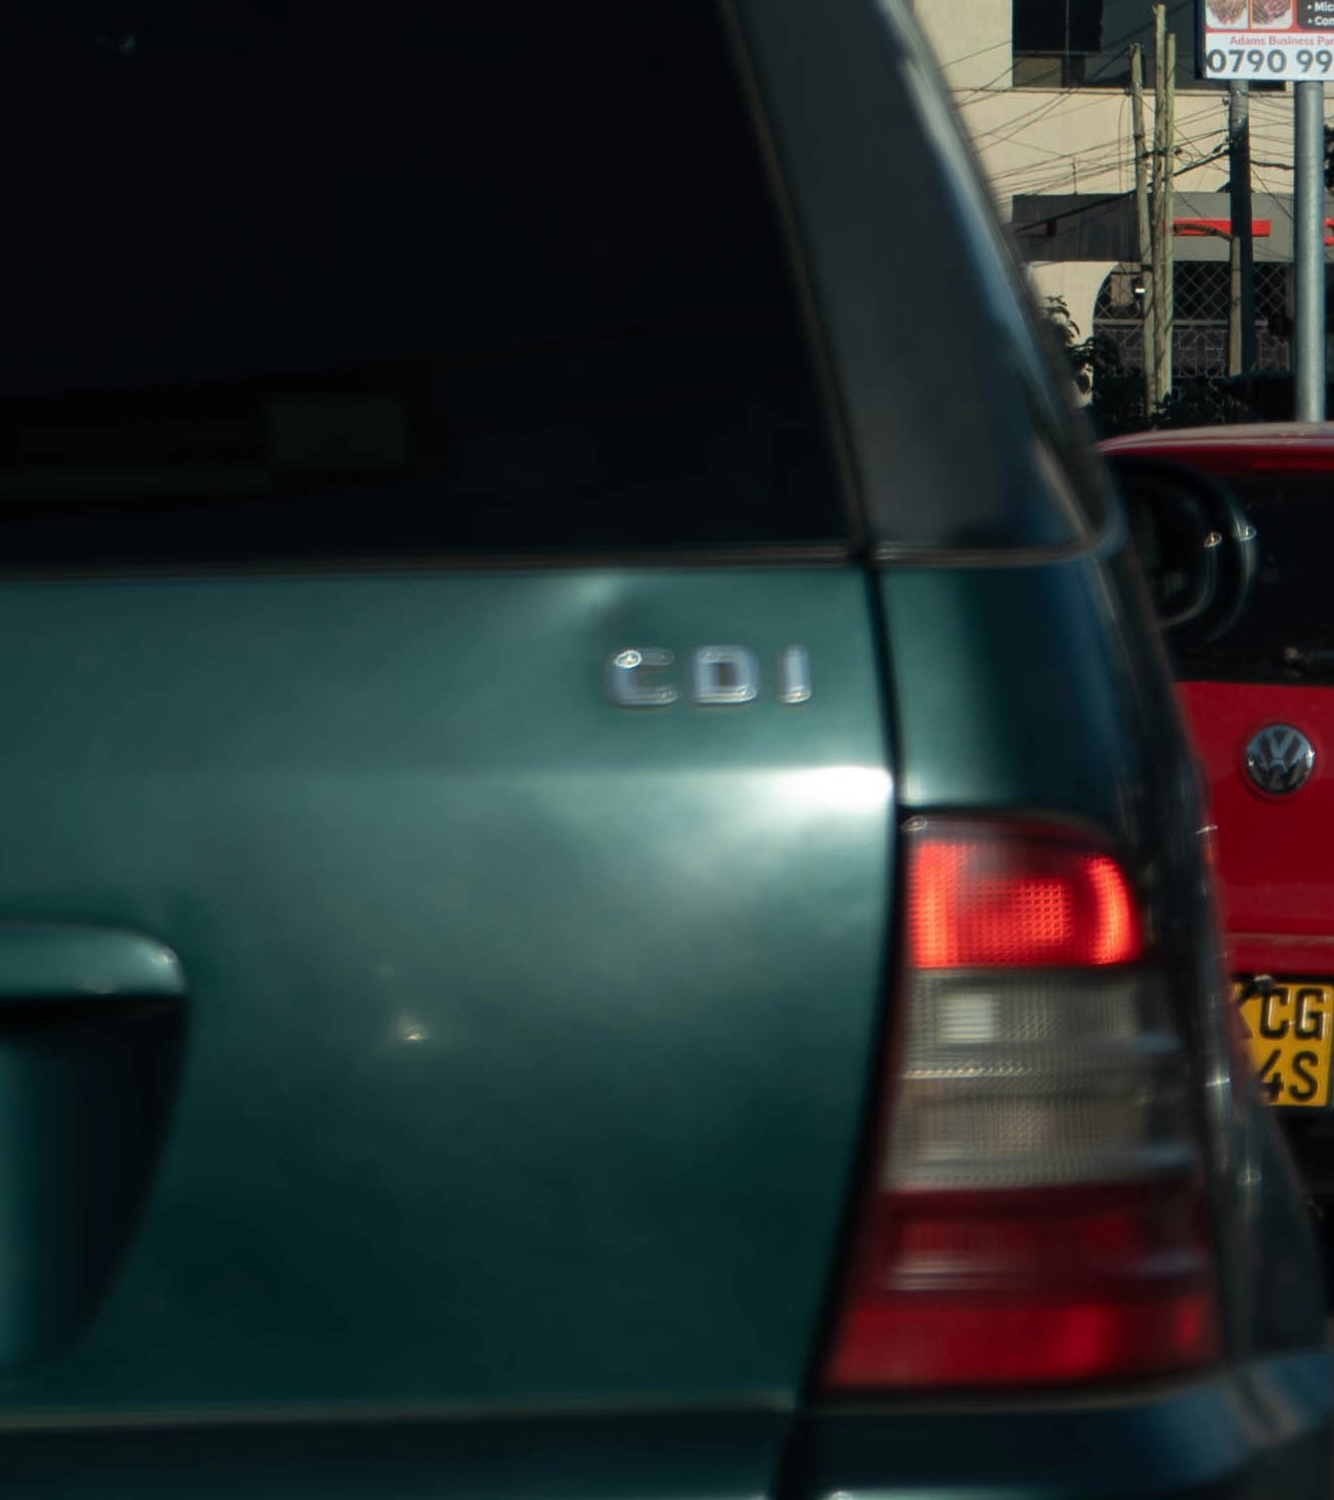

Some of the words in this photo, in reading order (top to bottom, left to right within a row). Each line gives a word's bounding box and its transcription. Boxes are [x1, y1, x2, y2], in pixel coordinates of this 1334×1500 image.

[1229, 35, 1265, 45] Adams
[1268, 35, 1315, 45] Business
[1206, 49, 1287, 73] 0790
[607, 646, 813, 706] CDI
